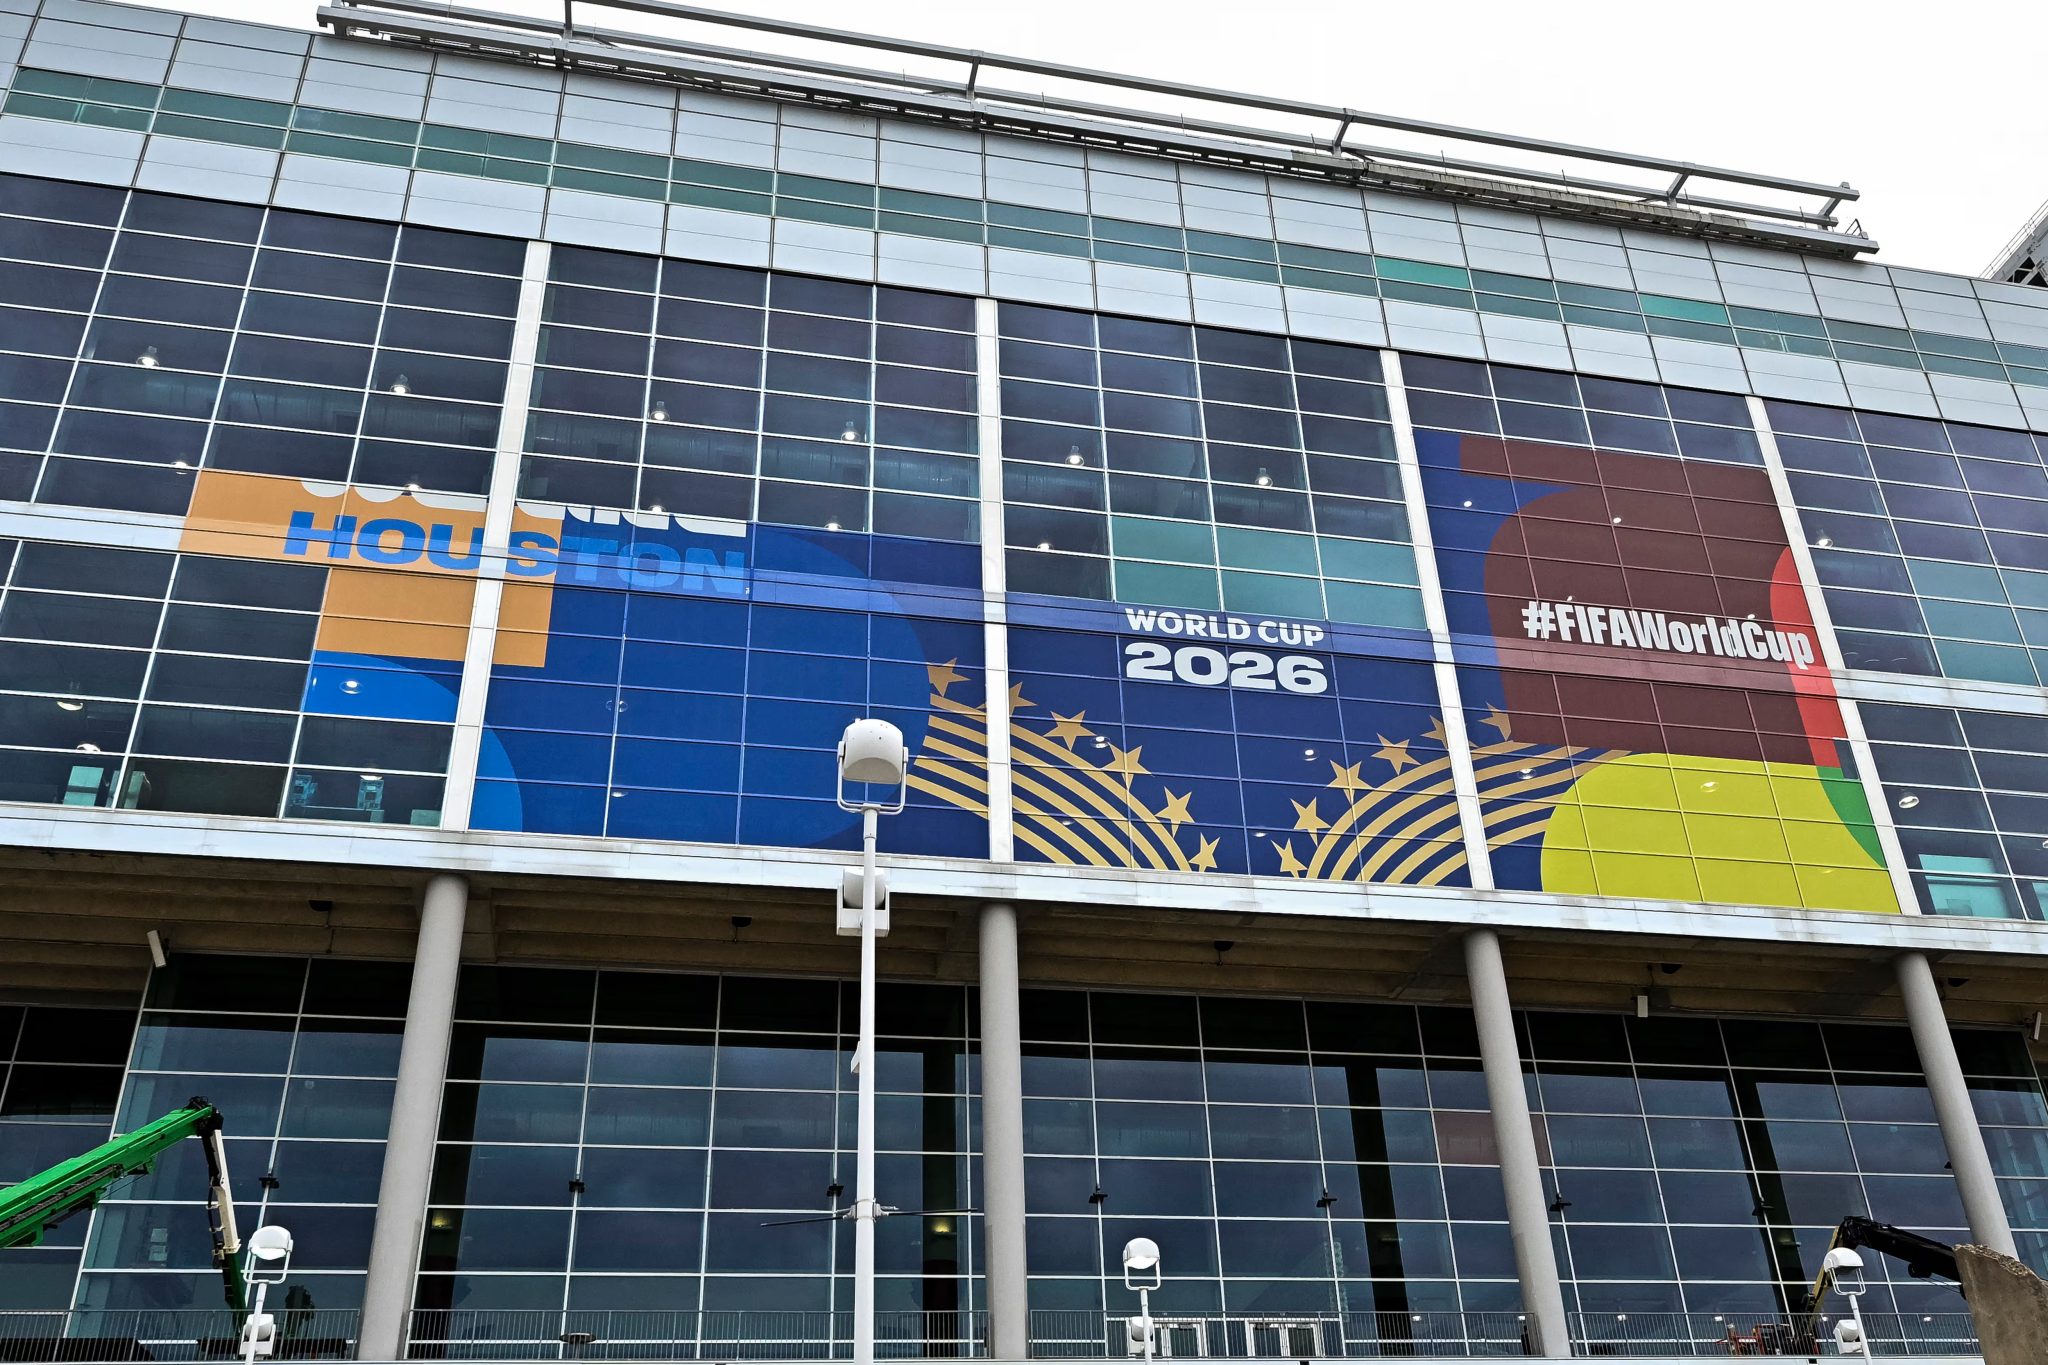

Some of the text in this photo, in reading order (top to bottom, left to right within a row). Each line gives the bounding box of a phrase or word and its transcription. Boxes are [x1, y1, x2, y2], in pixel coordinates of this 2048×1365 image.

[283, 510, 745, 594] HOUSTON
[1125, 608, 1324, 647] WORLD CUP
[1521, 600, 1815, 670] #FIFAWorldCup
[1125, 642, 1328, 694] 2026
